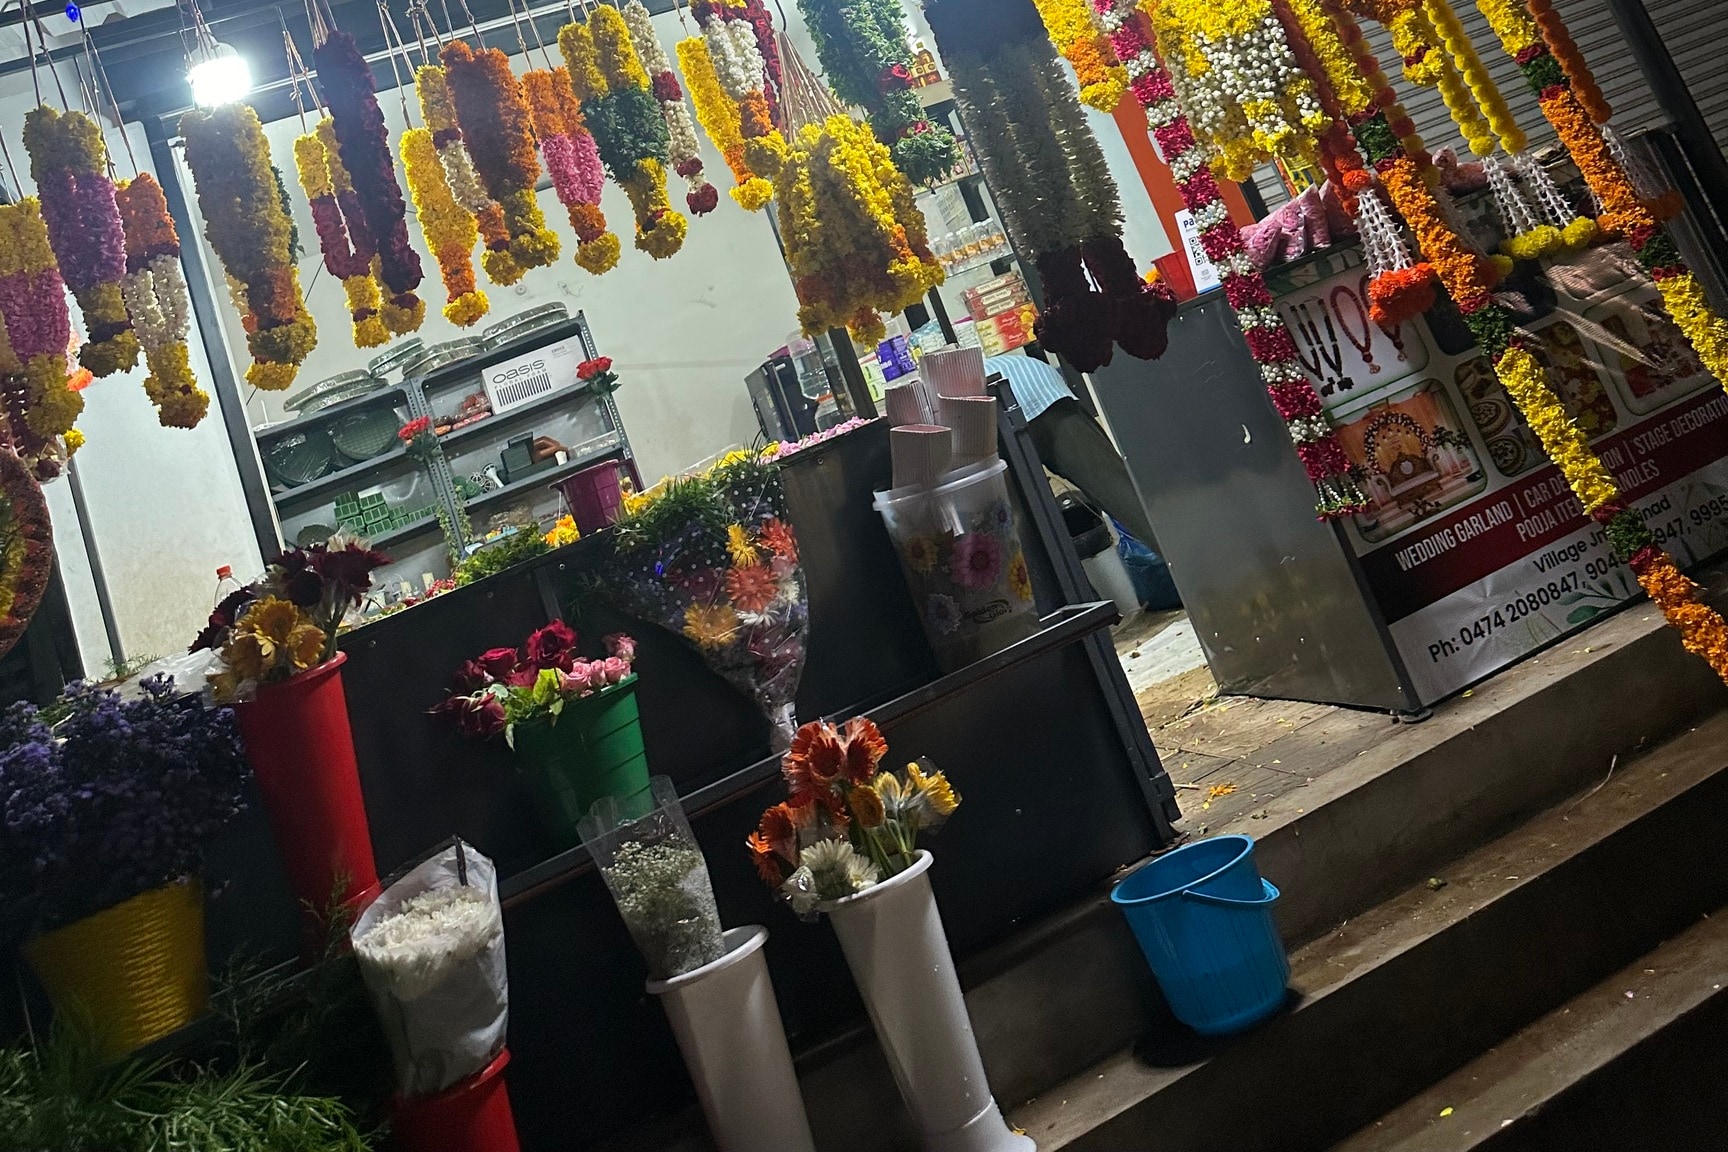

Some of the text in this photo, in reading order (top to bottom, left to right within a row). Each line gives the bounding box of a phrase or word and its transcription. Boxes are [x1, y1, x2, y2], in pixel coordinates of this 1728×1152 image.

[1395, 528, 1457, 572] WEDDING
[1454, 500, 1514, 543] GARLAND
[1523, 479, 1553, 509] CAR
[1632, 423, 1673, 455] STAGE
[1516, 509, 1560, 542] POOJA
[1533, 540, 1588, 574] Village
[1428, 636, 1460, 663] Ph:
[1459, 610, 1506, 646] 0474
[1505, 570, 1586, 623] 2080847,
